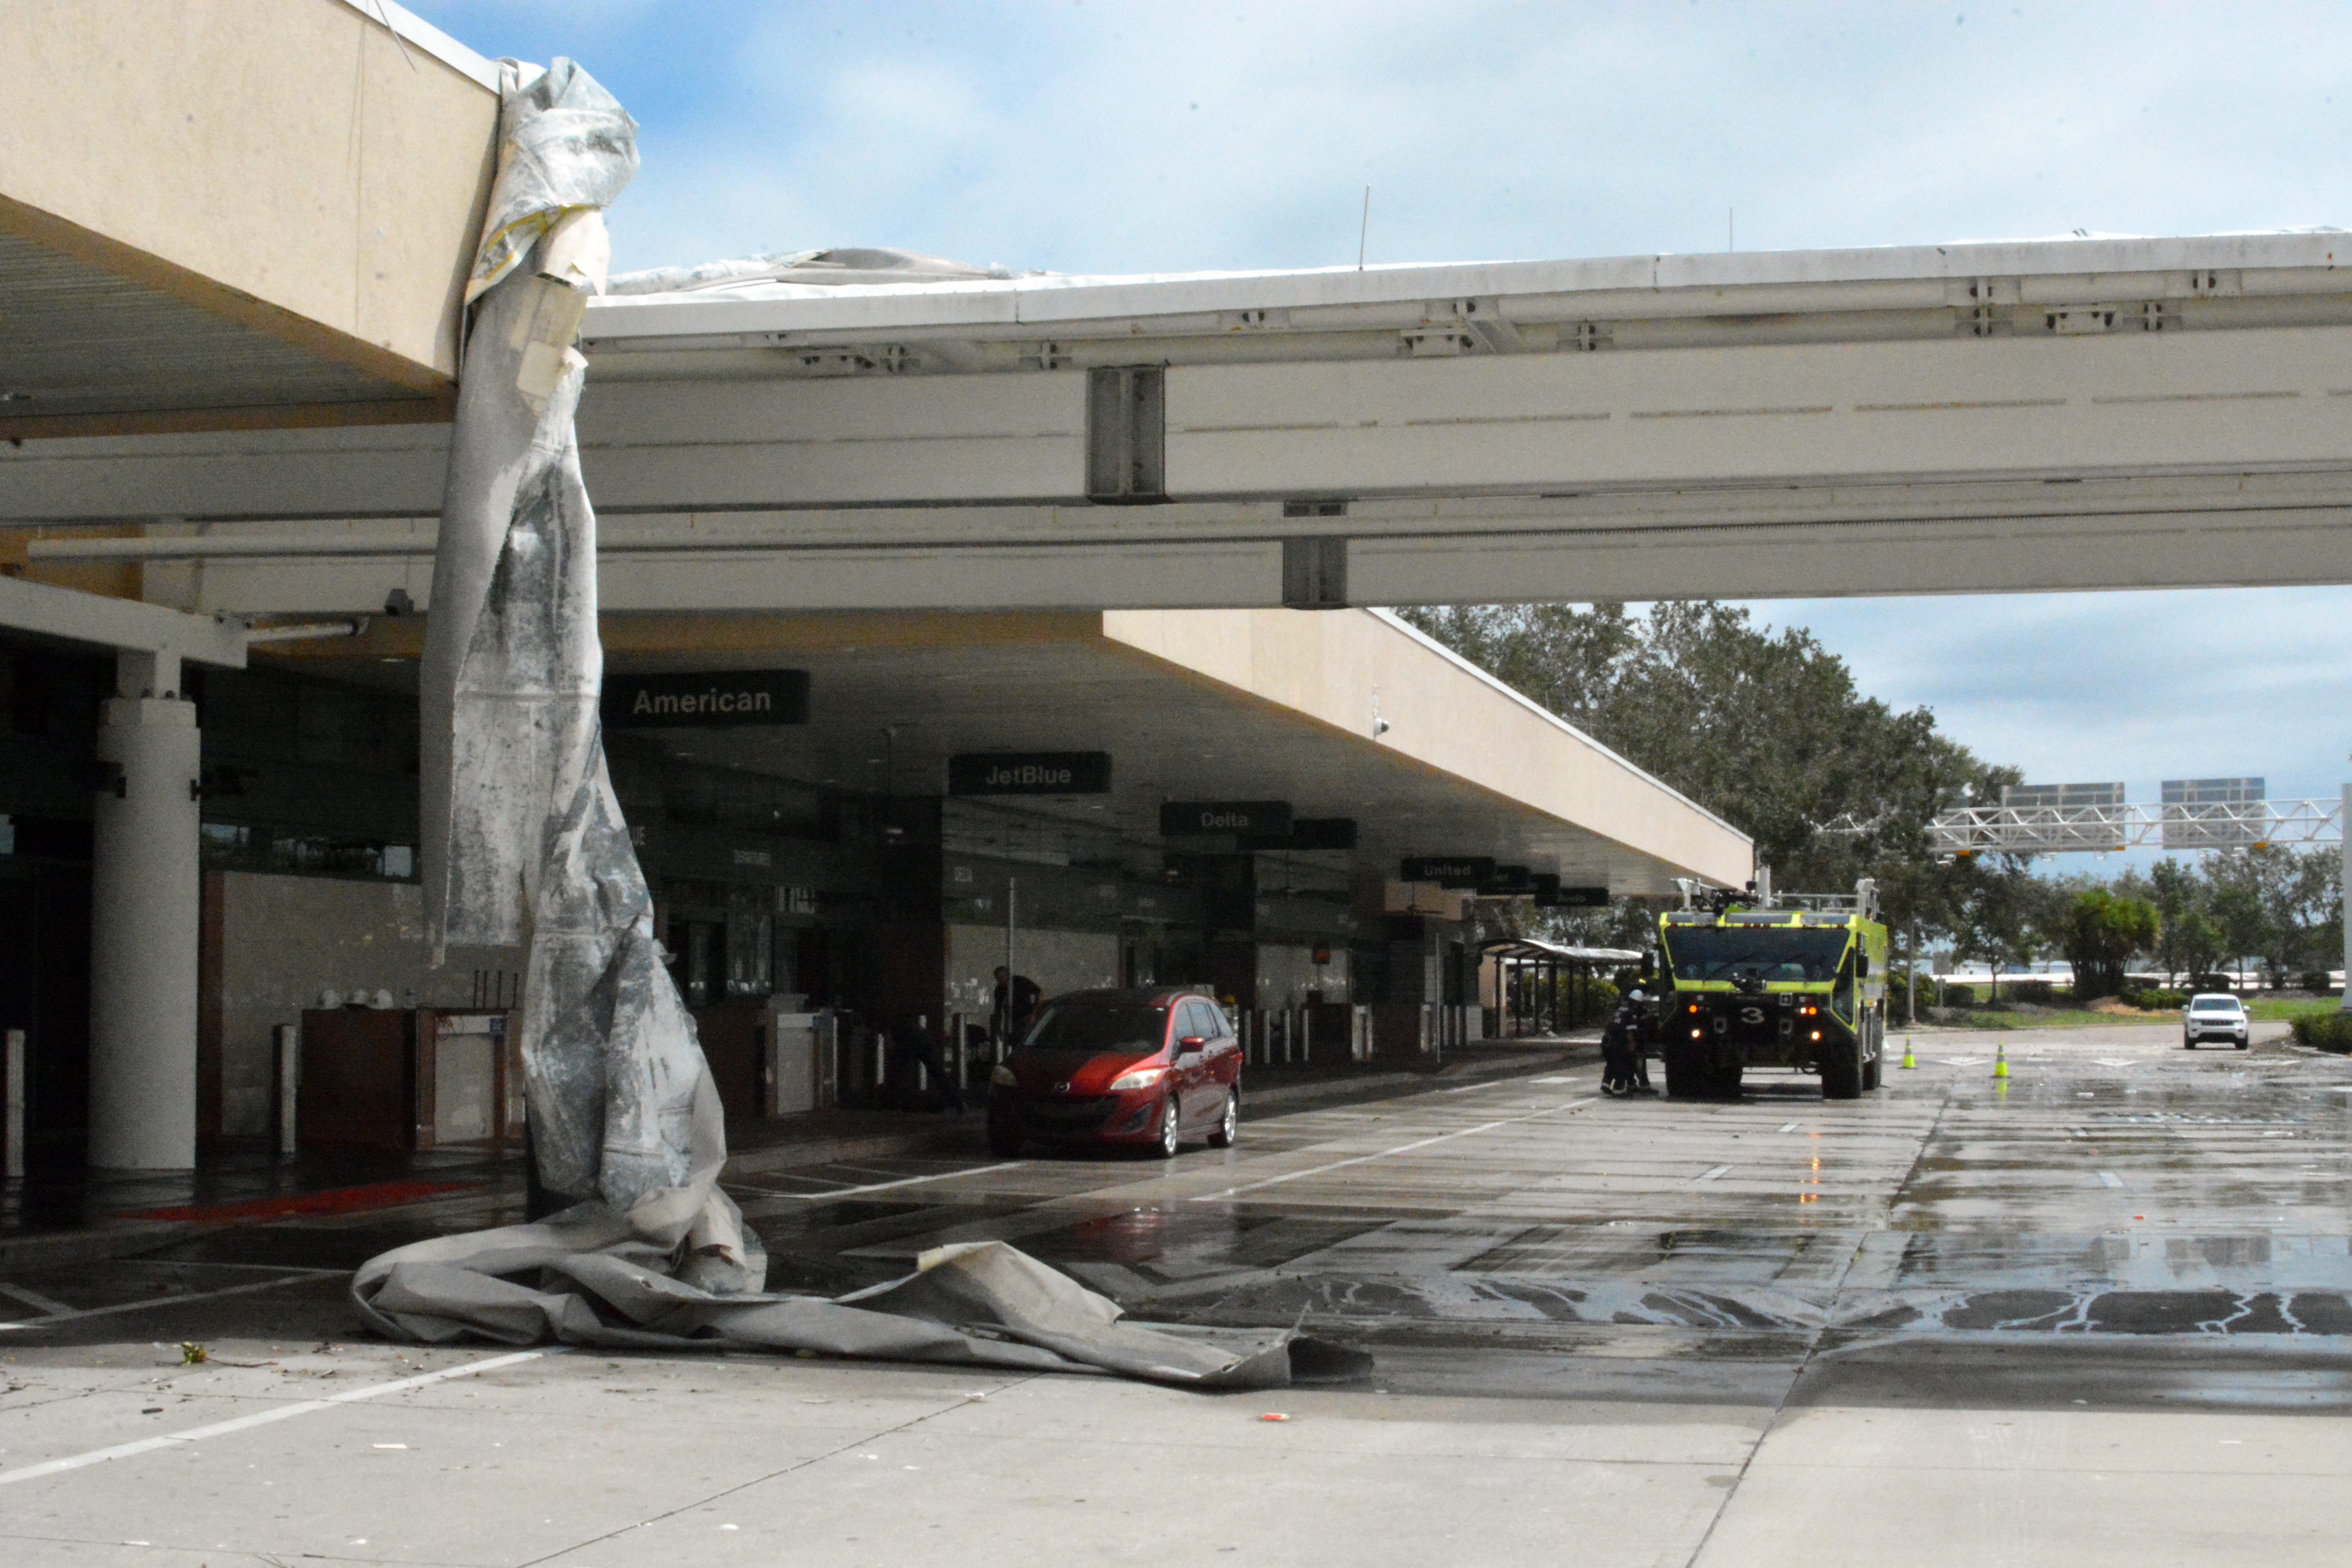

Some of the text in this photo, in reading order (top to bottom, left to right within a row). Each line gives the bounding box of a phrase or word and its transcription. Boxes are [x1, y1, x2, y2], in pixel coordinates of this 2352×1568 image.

[633, 688, 771, 714] American
[985, 765, 1072, 785] JetBlue
[1201, 812, 1249, 827] Delta
[1424, 864, 1471, 877] United
[1741, 1007, 1765, 1024] 3
